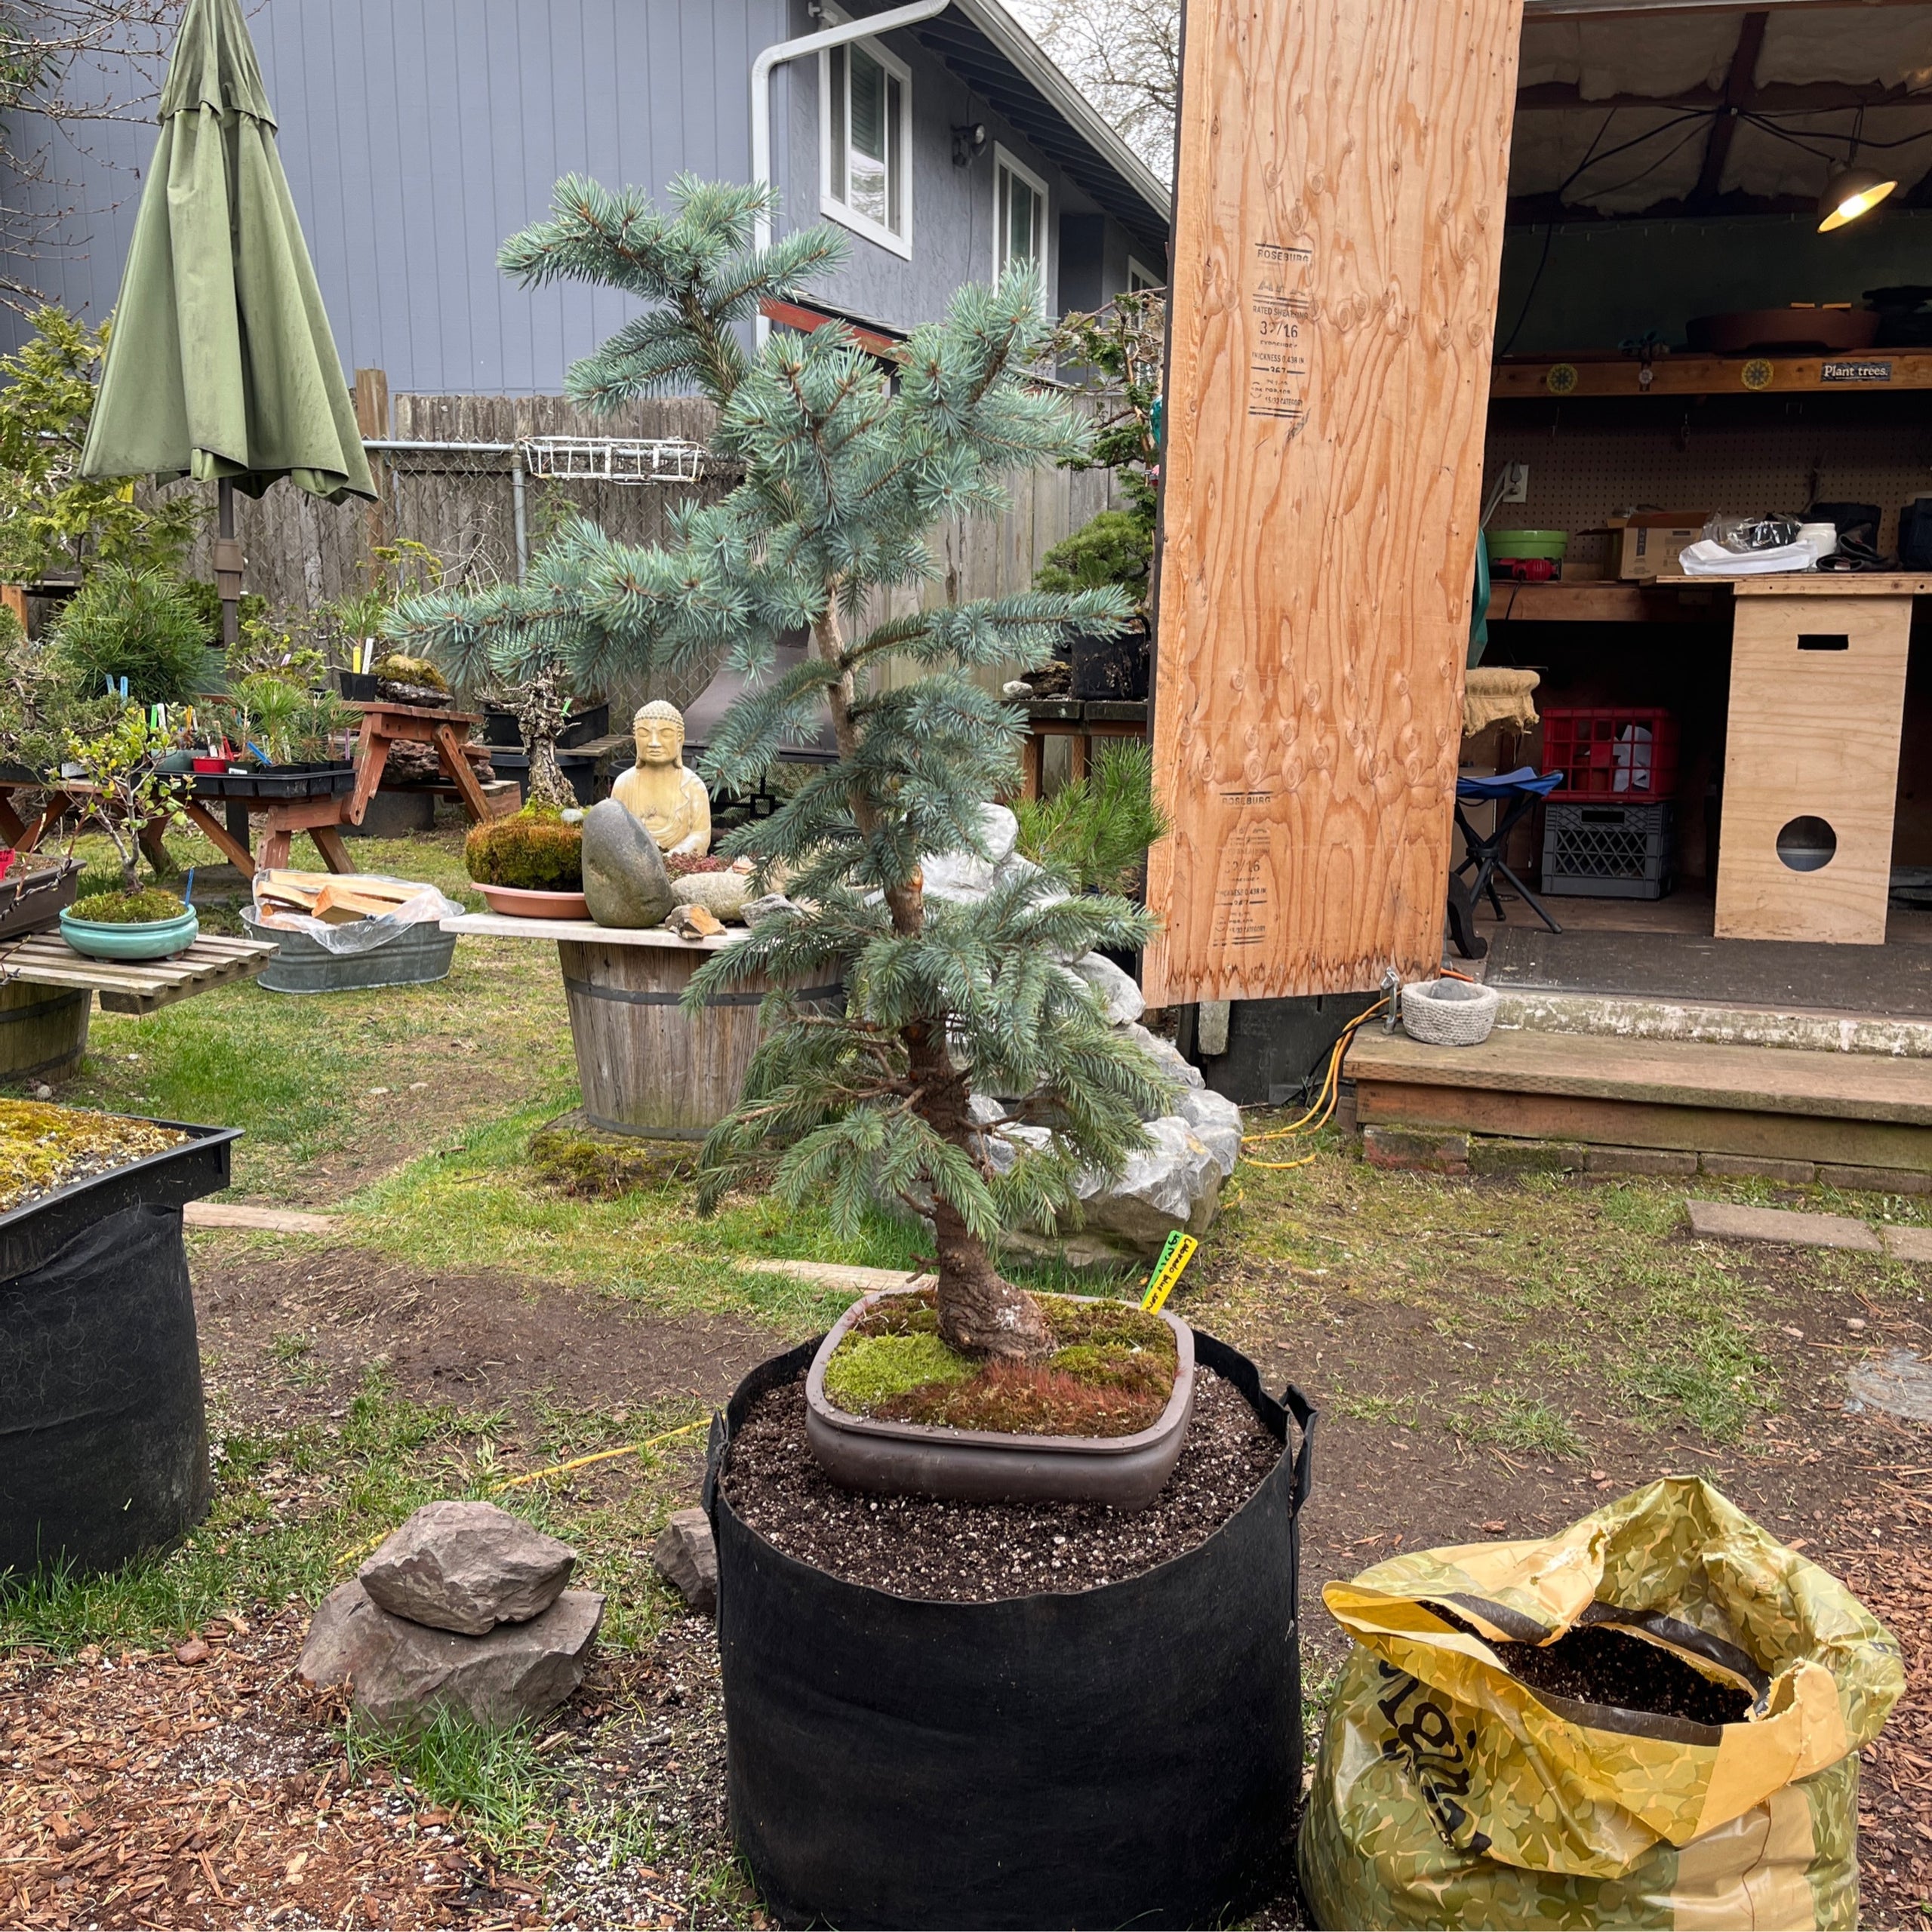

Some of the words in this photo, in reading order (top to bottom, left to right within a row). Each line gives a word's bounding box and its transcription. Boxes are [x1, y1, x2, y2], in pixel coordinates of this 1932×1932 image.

[1253, 305, 1272, 316] RATED
[1824, 365, 1854, 377] Plant
[1858, 367, 1888, 376] trees.
[1223, 796, 1271, 805] ROSEBURG
[1157, 1274, 1172, 1292] blue
